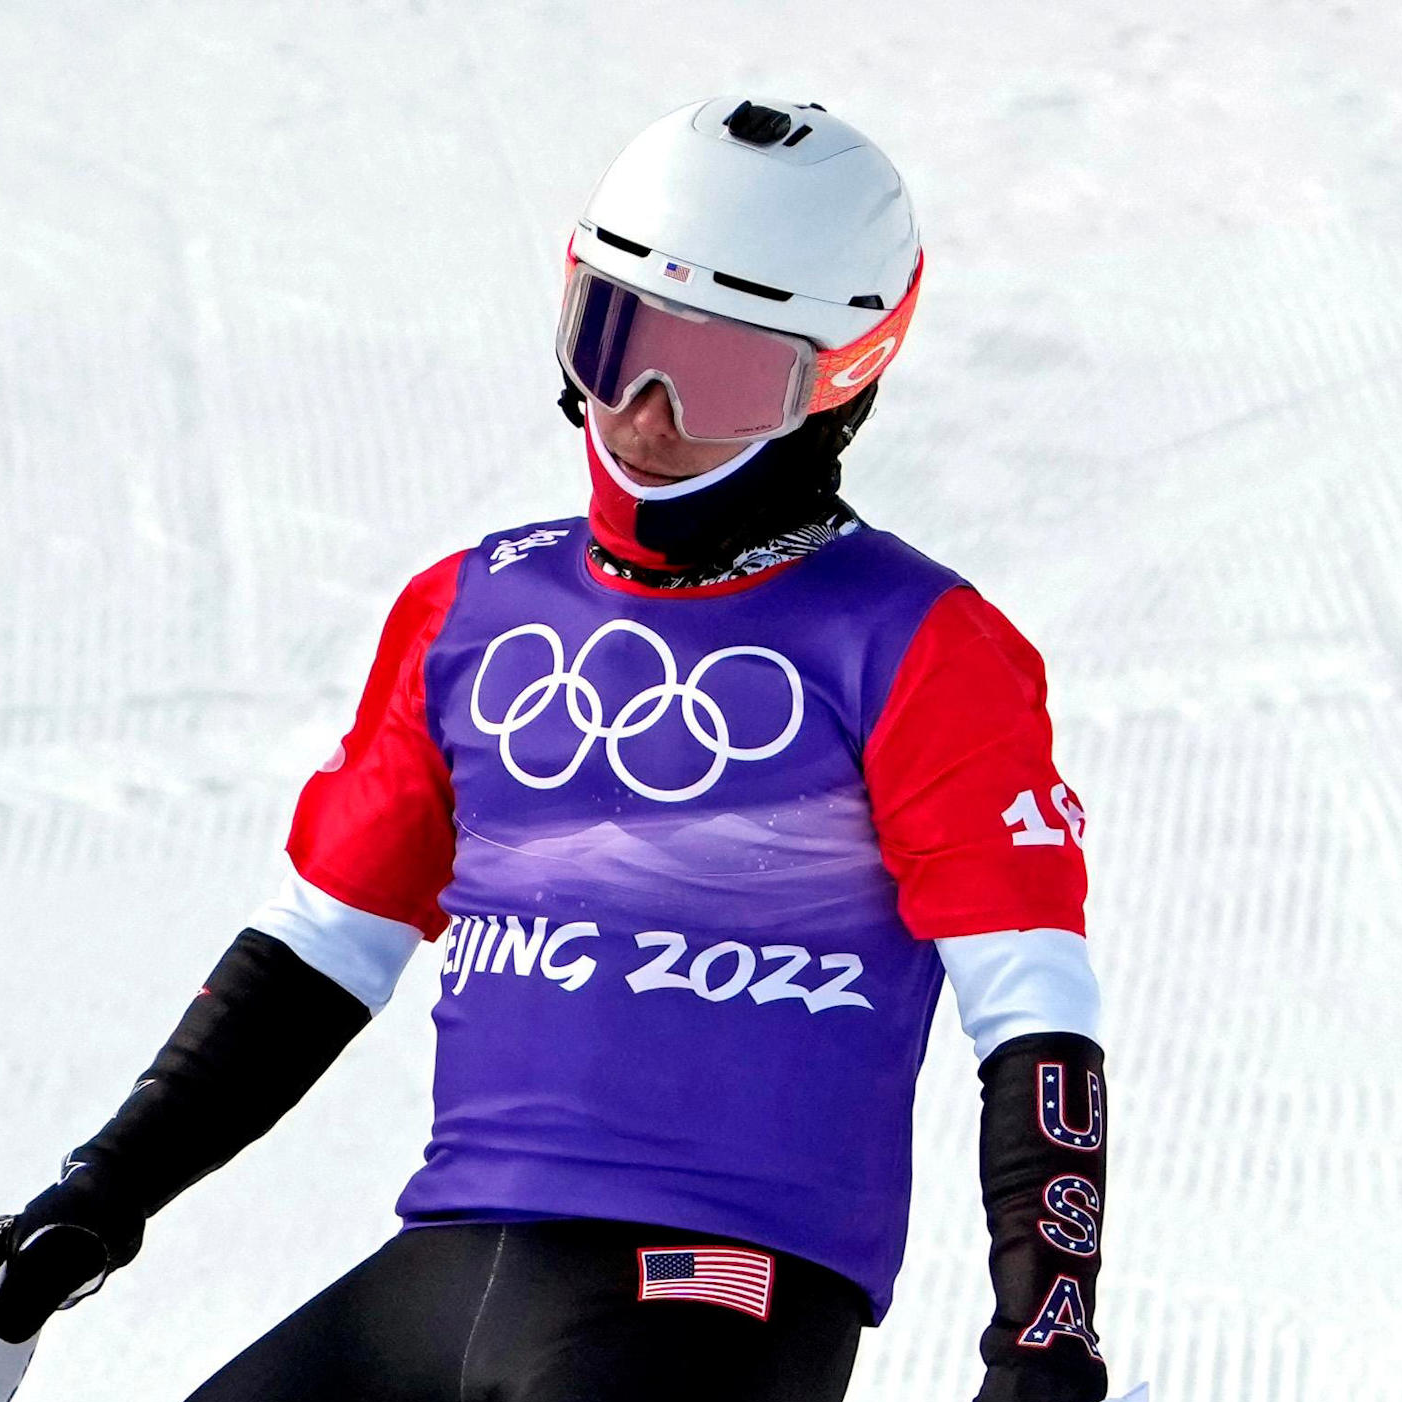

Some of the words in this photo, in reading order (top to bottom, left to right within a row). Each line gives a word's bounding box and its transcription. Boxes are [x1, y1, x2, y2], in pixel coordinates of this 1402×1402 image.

[442, 914, 601, 996] EIJING
[624, 930, 876, 1015] 2022
[1017, 1062, 1105, 1362] USA
